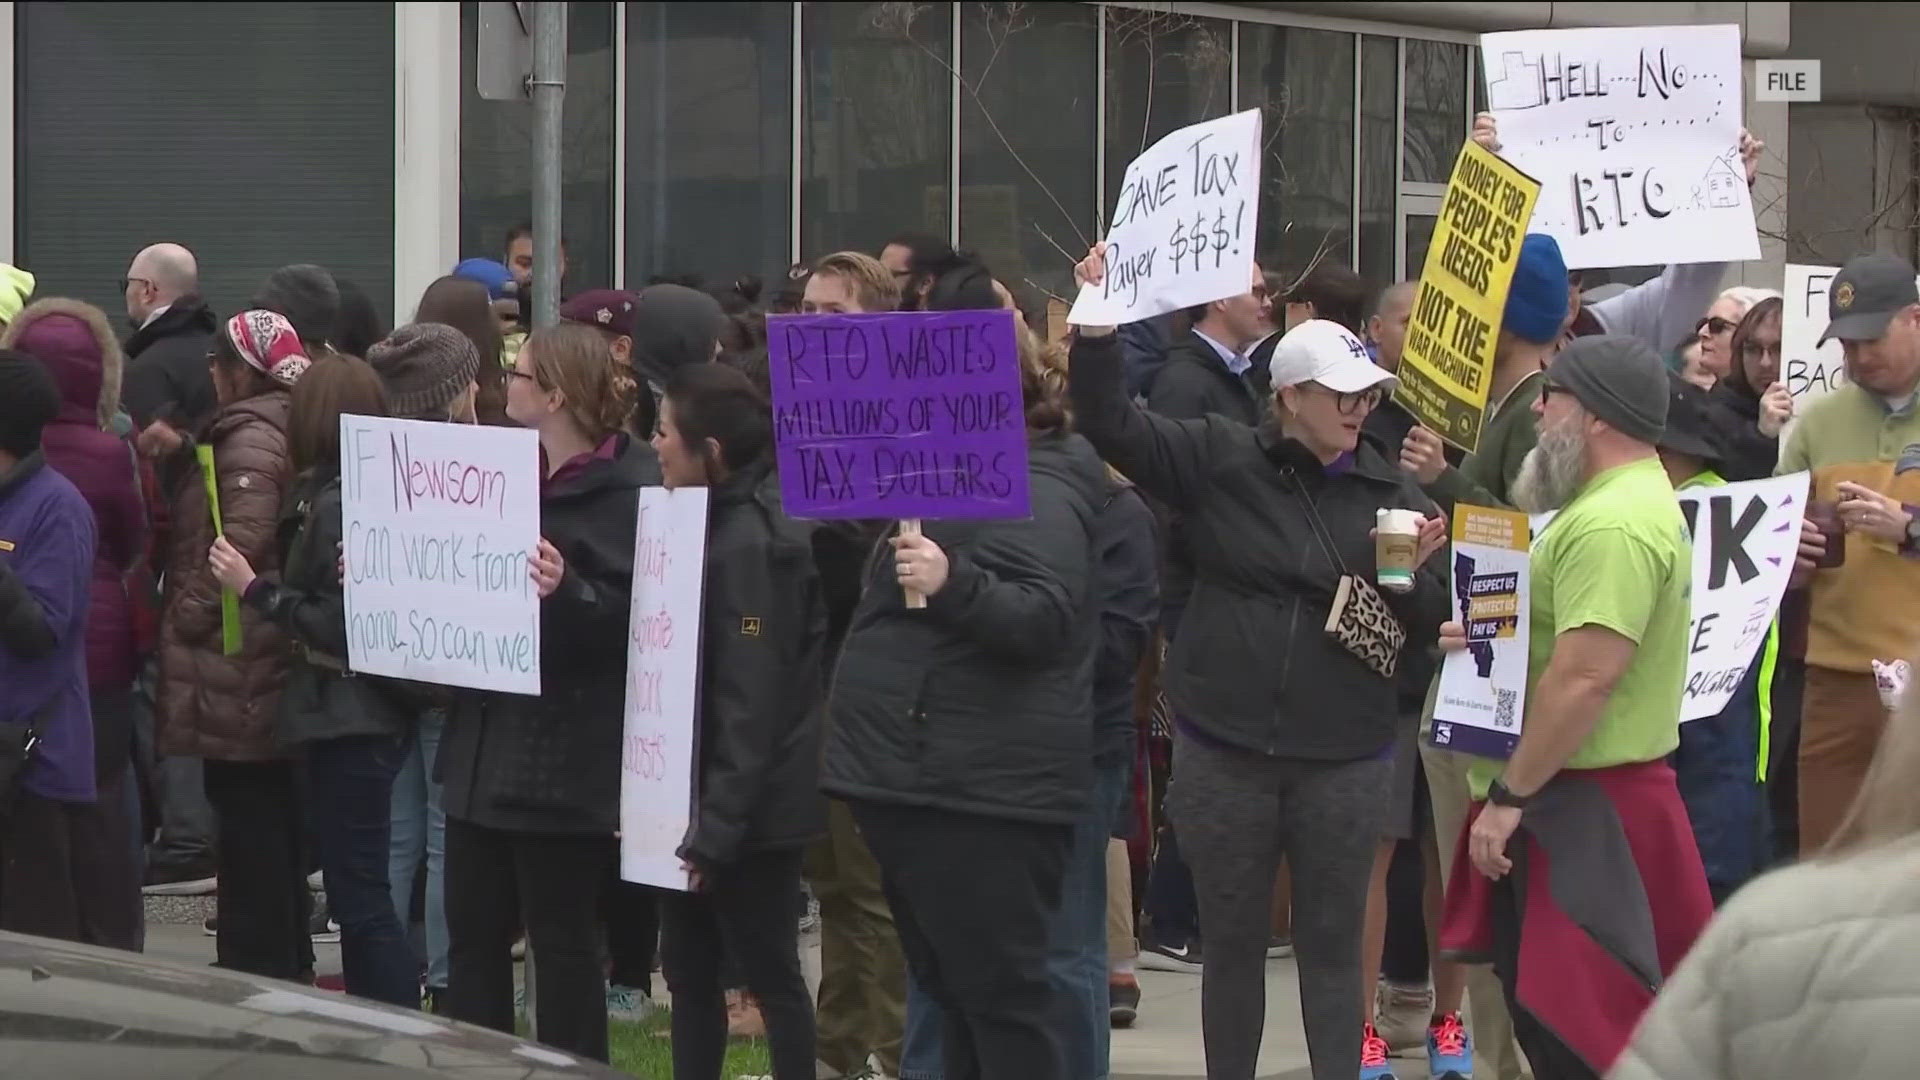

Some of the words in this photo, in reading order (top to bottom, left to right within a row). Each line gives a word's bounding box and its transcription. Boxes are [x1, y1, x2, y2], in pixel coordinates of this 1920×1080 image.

[1540, 51, 1608, 104] HELL
[1187, 133, 1239, 198] Tax
[1457, 151, 1502, 205] MONEY
[1499, 181, 1528, 224] FOR
[1443, 184, 1516, 263] PEOPLE'S
[1571, 167, 1676, 236] RTO
[1103, 243, 1157, 308] Payer
[1169, 200, 1245, 275] $$$!
[1441, 230, 1493, 297] NEEDS
[786, 323, 869, 390] RTO
[881, 322, 997, 380] WASTES
[1416, 281, 1455, 338] NOT
[1451, 305, 1491, 366] THE
[1408, 324, 1430, 360] WAR
[1429, 341, 1482, 394] MACHINE!
[776, 396, 899, 441] MILLIONS
[908, 396, 933, 432] OF
[942, 391, 1012, 434] YOUR
[390, 431, 506, 518] Newsom
[796, 448, 855, 500] TAX
[874, 447, 1012, 499] DOLLARS
[471, 533, 529, 600] from
[1471, 577, 1505, 593] RESPECT
[1505, 575, 1516, 589] US
[1471, 600, 1505, 615] PROTECT
[1504, 598, 1516, 612] US
[1471, 623, 1488, 637] PAY
[1487, 621, 1498, 635] US
[441, 622, 488, 673] can
[495, 613, 538, 673] we!
